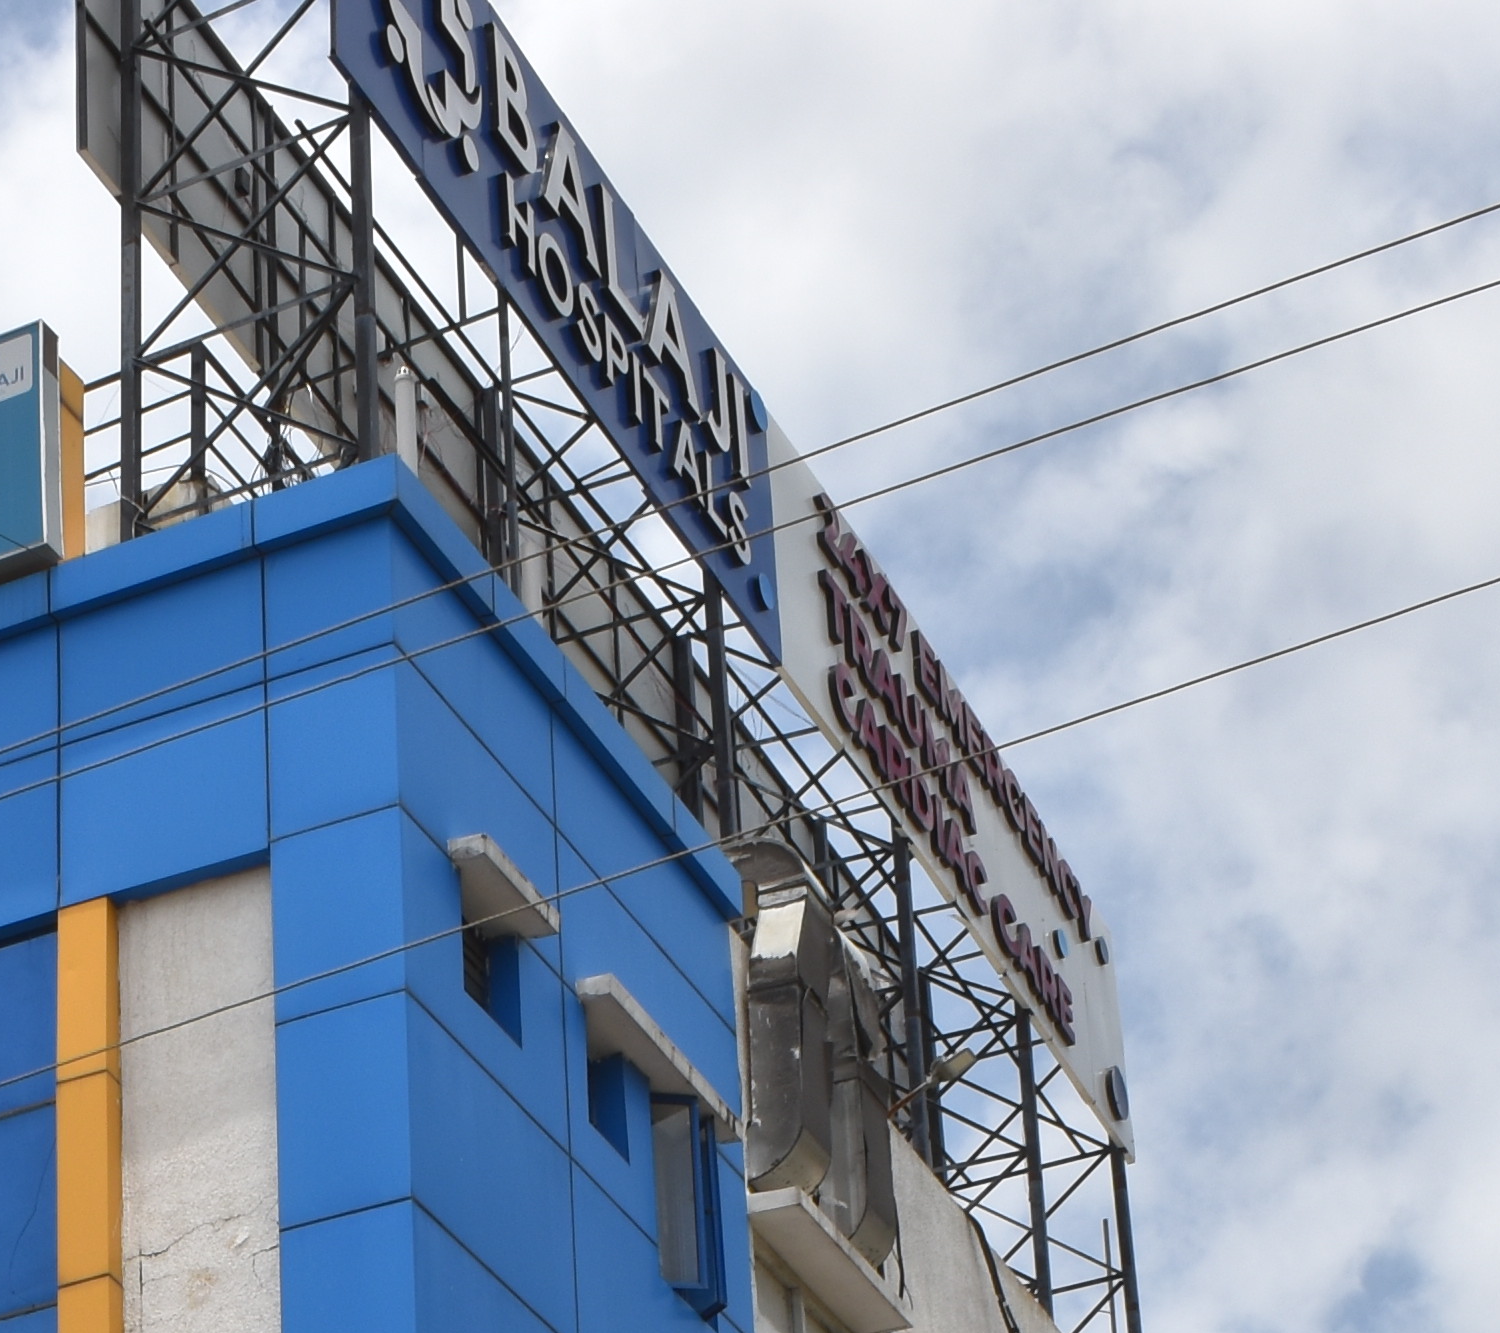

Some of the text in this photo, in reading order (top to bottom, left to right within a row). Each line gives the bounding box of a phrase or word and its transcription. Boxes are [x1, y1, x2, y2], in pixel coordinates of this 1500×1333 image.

[490, 20, 752, 489] BALAJI
[503, 171, 752, 566] HOSPITALS
[817, 569, 976, 835] TRAUMA
[829, 662, 1075, 1046] CARDIAC CARE
[911, 630, 1092, 942] EMERGENCY
